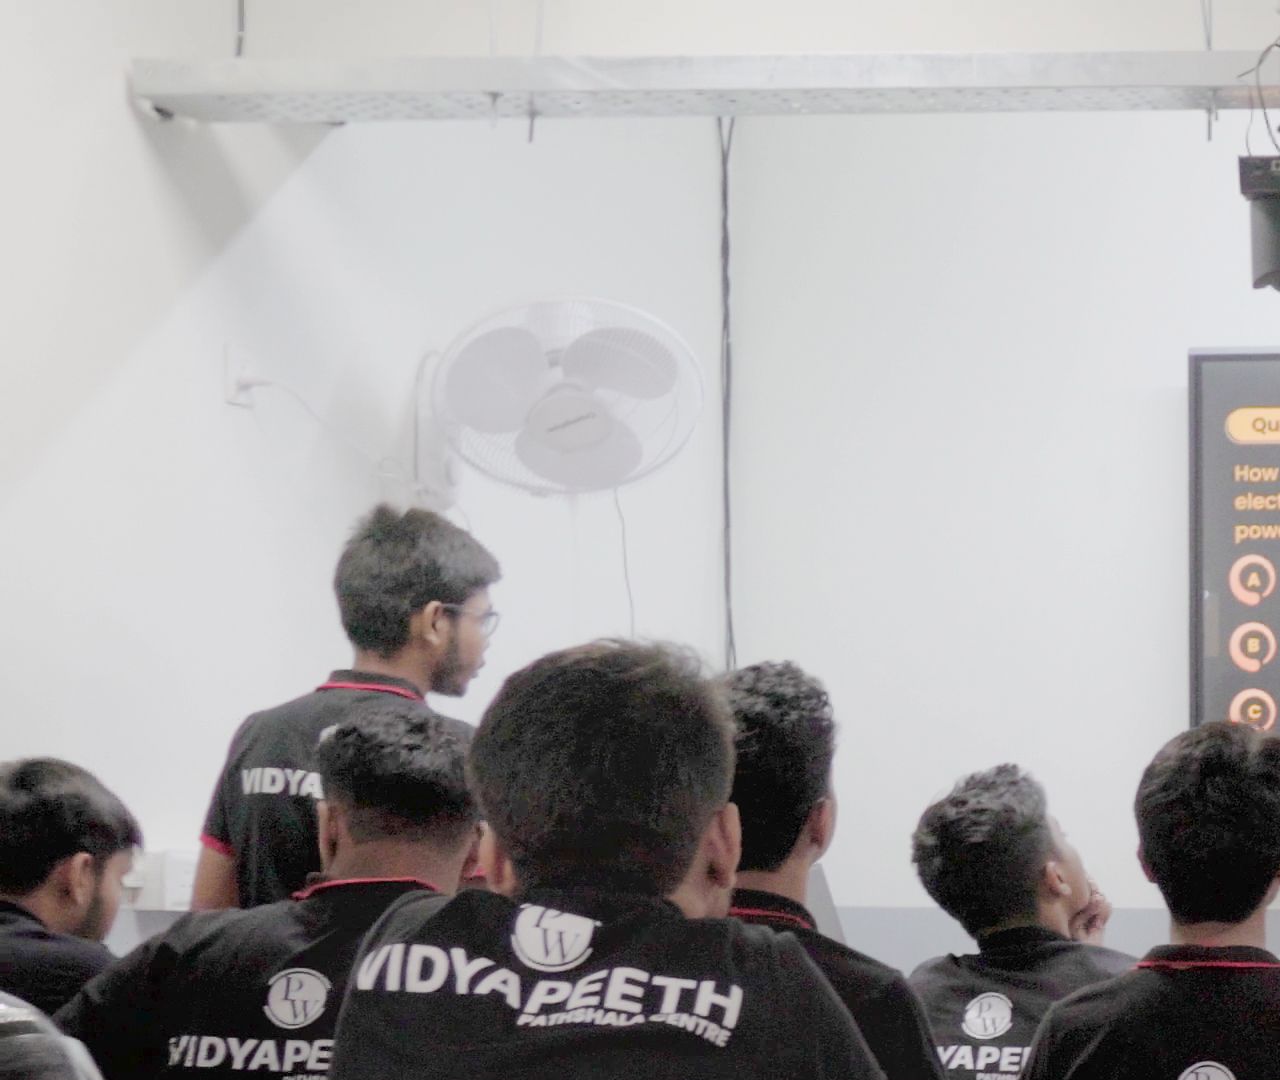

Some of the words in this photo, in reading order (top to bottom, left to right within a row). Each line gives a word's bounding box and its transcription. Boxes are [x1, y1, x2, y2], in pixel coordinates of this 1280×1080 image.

[1233, 464, 1279, 481] How
[1246, 572, 1261, 588] A
[1246, 638, 1260, 653] B
[1247, 704, 1262, 719] C
[356, 942, 743, 1029] VIDYAPEETH
